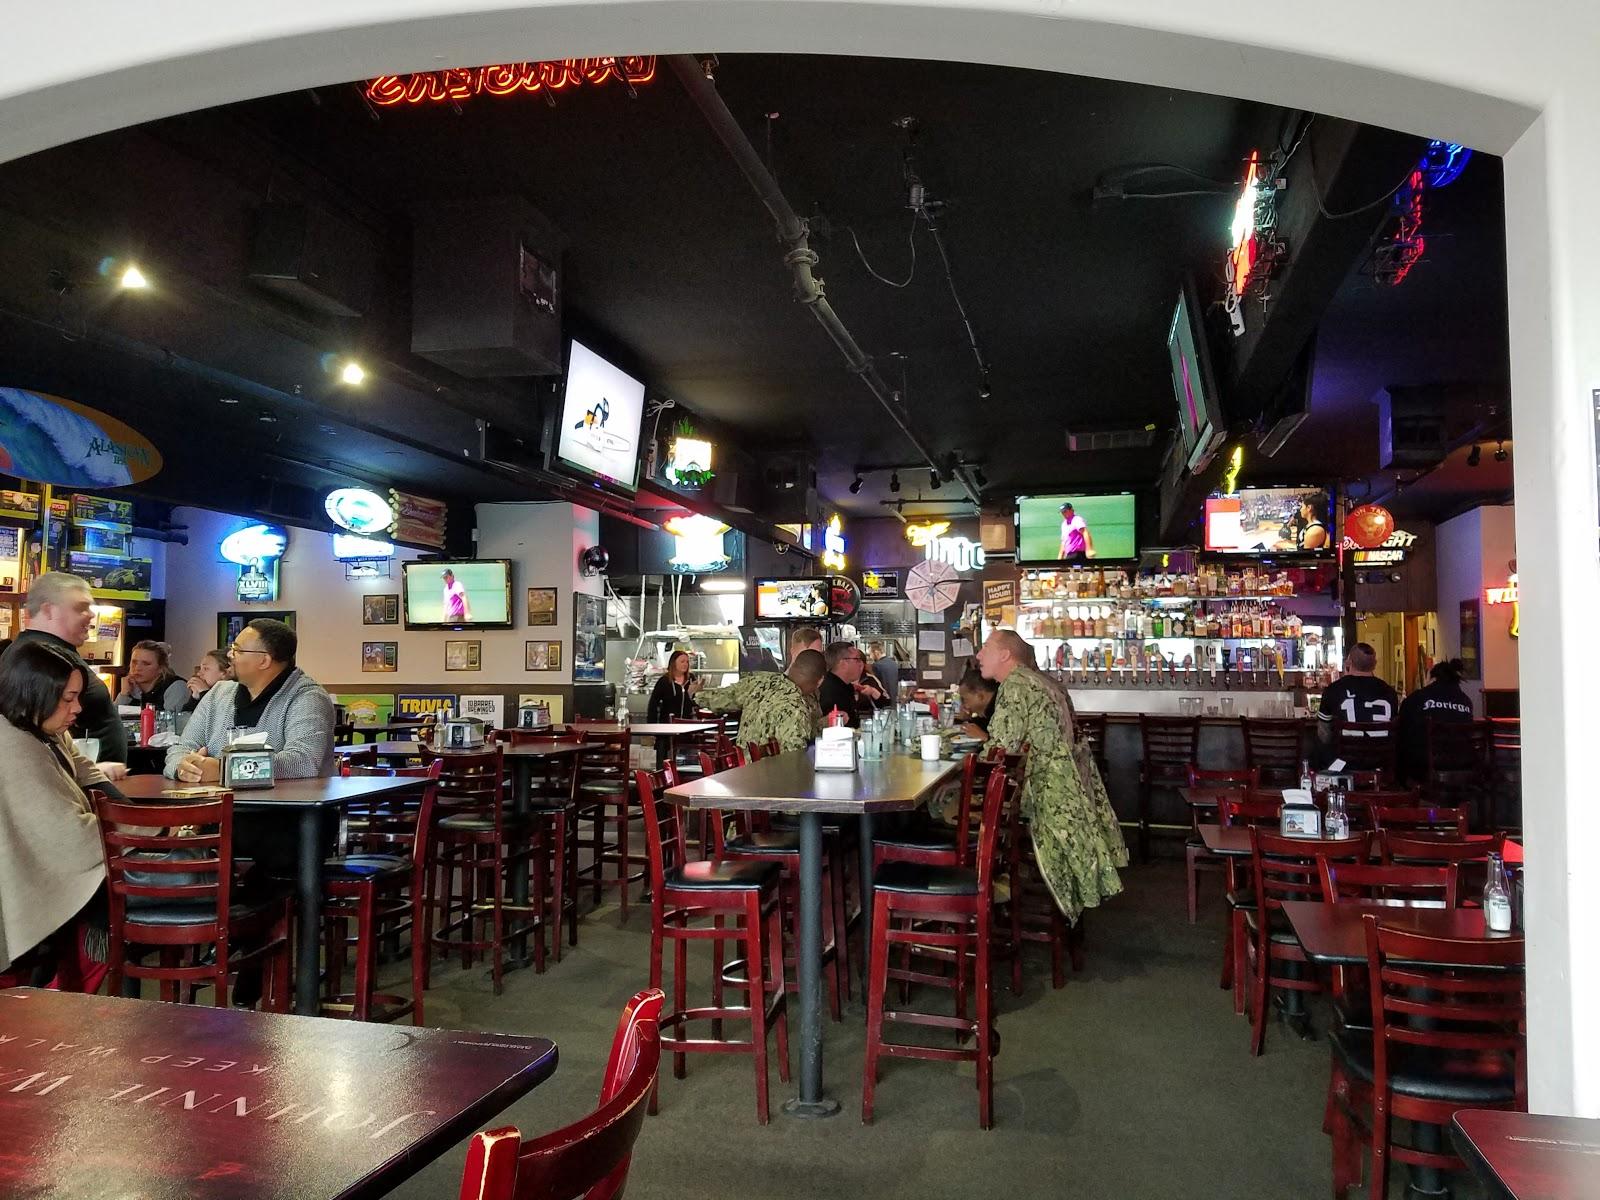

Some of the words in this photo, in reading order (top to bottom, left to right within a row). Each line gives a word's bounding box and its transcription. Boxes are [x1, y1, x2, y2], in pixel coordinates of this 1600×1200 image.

[1368, 550, 1404, 561] NASCAR
[987, 583, 1011, 594] HAPPY
[988, 590, 1011, 599] HOUR!
[140, 1054, 274, 1077] KEEP
